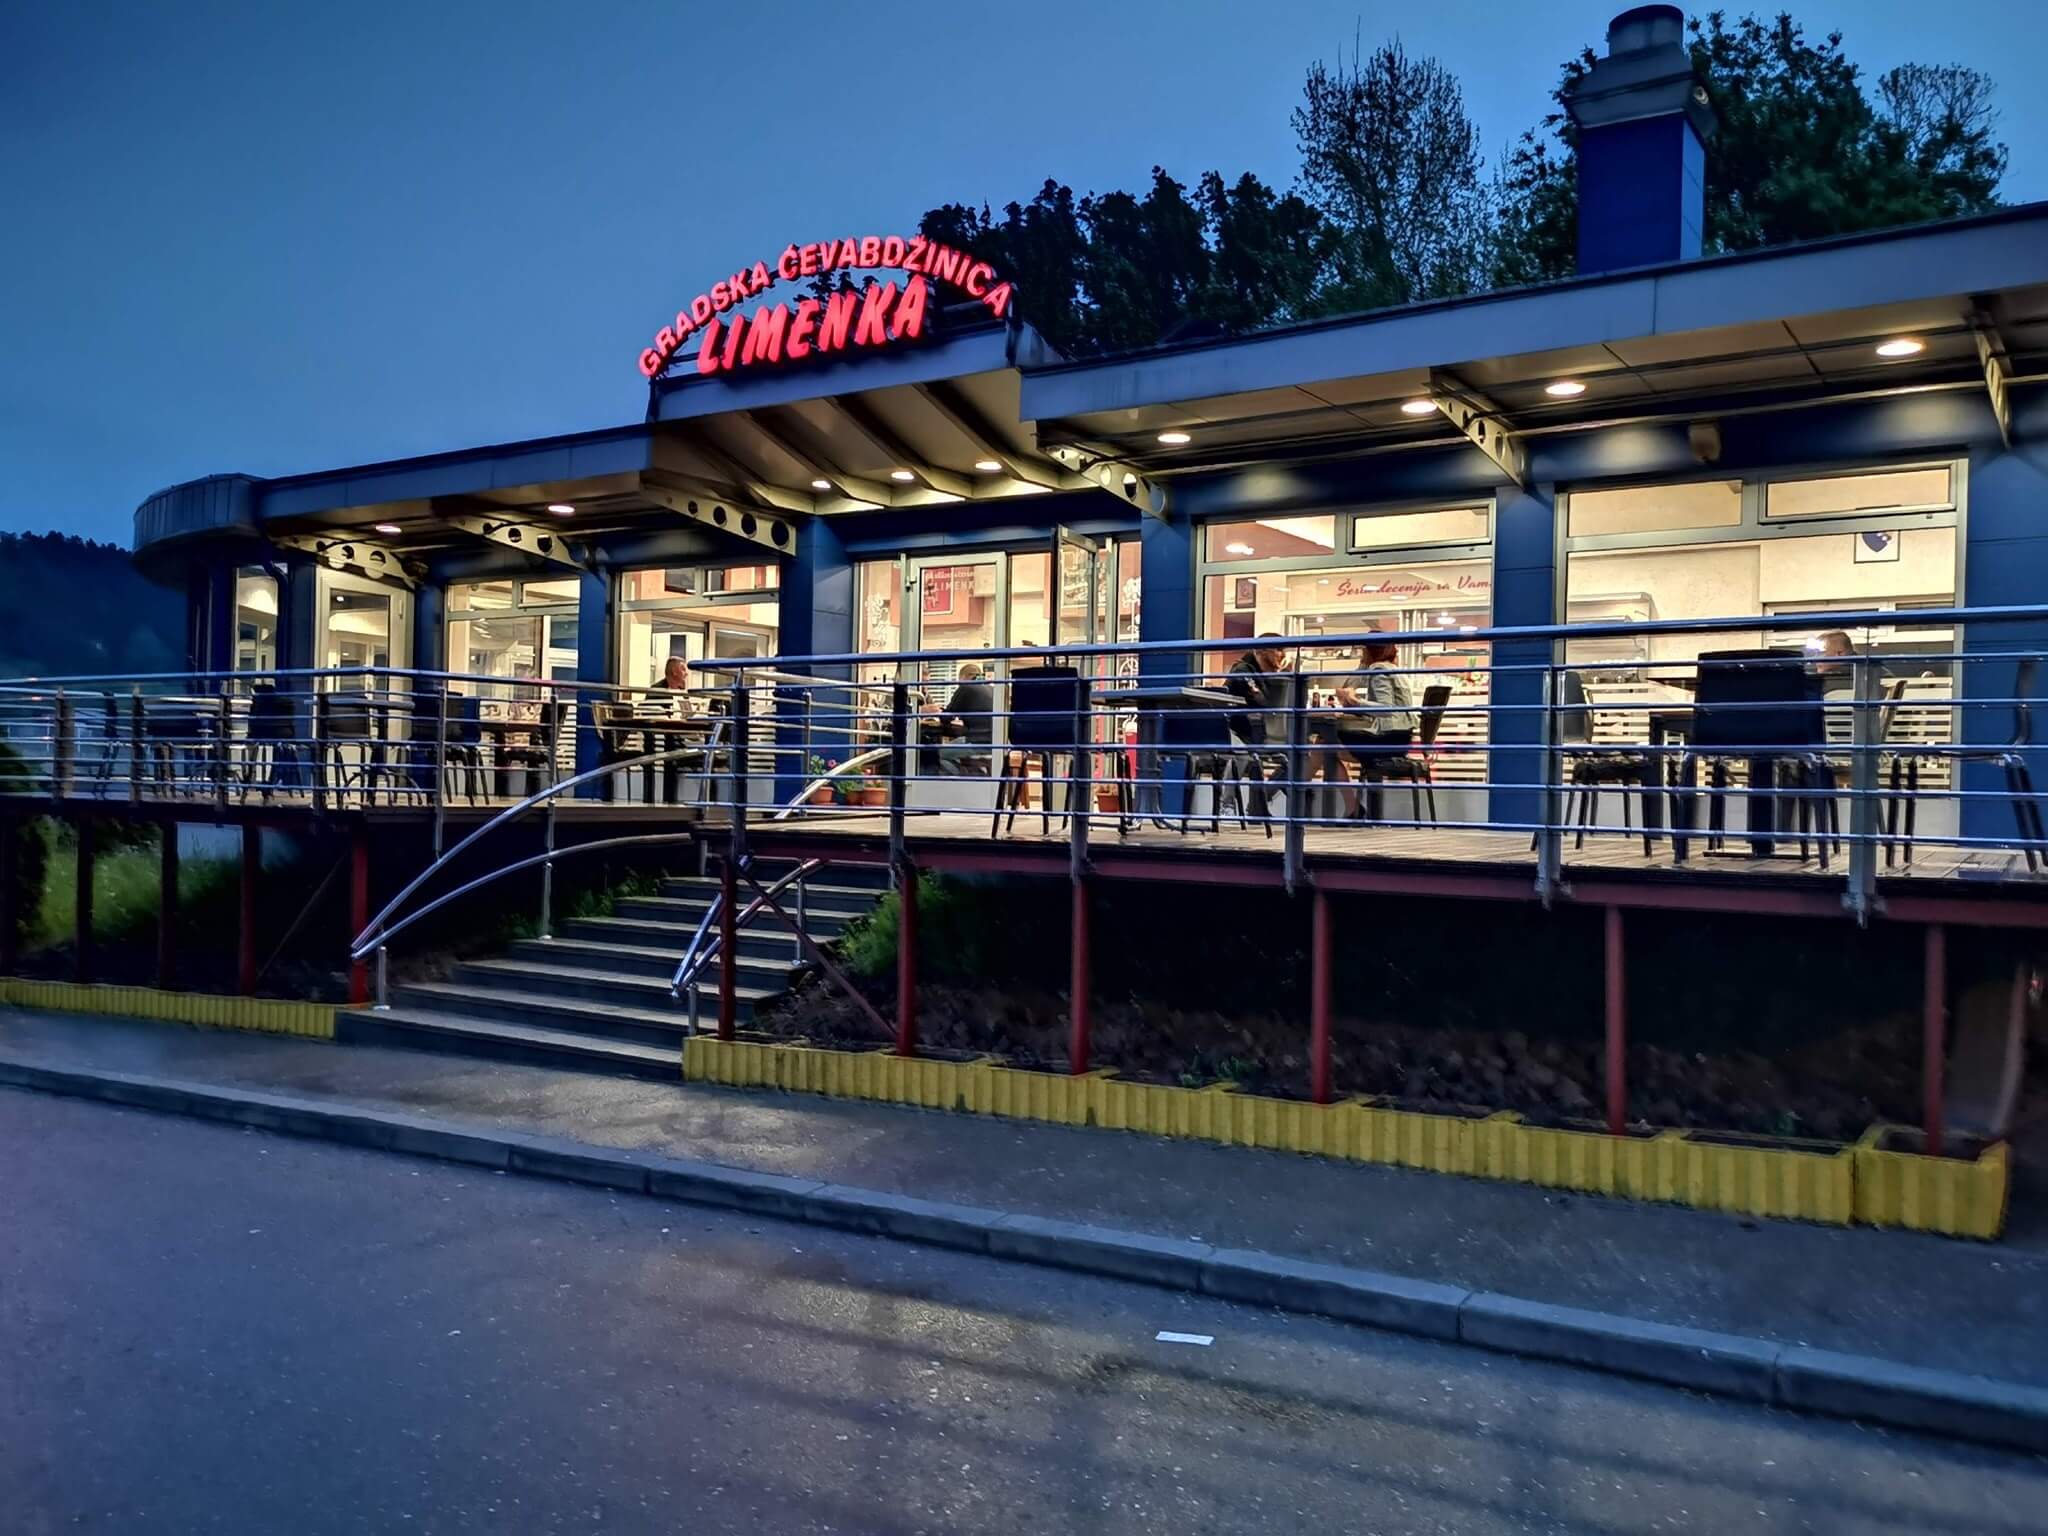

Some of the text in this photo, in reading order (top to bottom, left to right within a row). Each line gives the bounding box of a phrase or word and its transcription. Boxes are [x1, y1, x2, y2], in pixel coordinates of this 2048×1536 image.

[638, 233, 1012, 377] GRADSKA ĆEVABDŽINICA
[697, 273, 928, 375] LIMENKA
